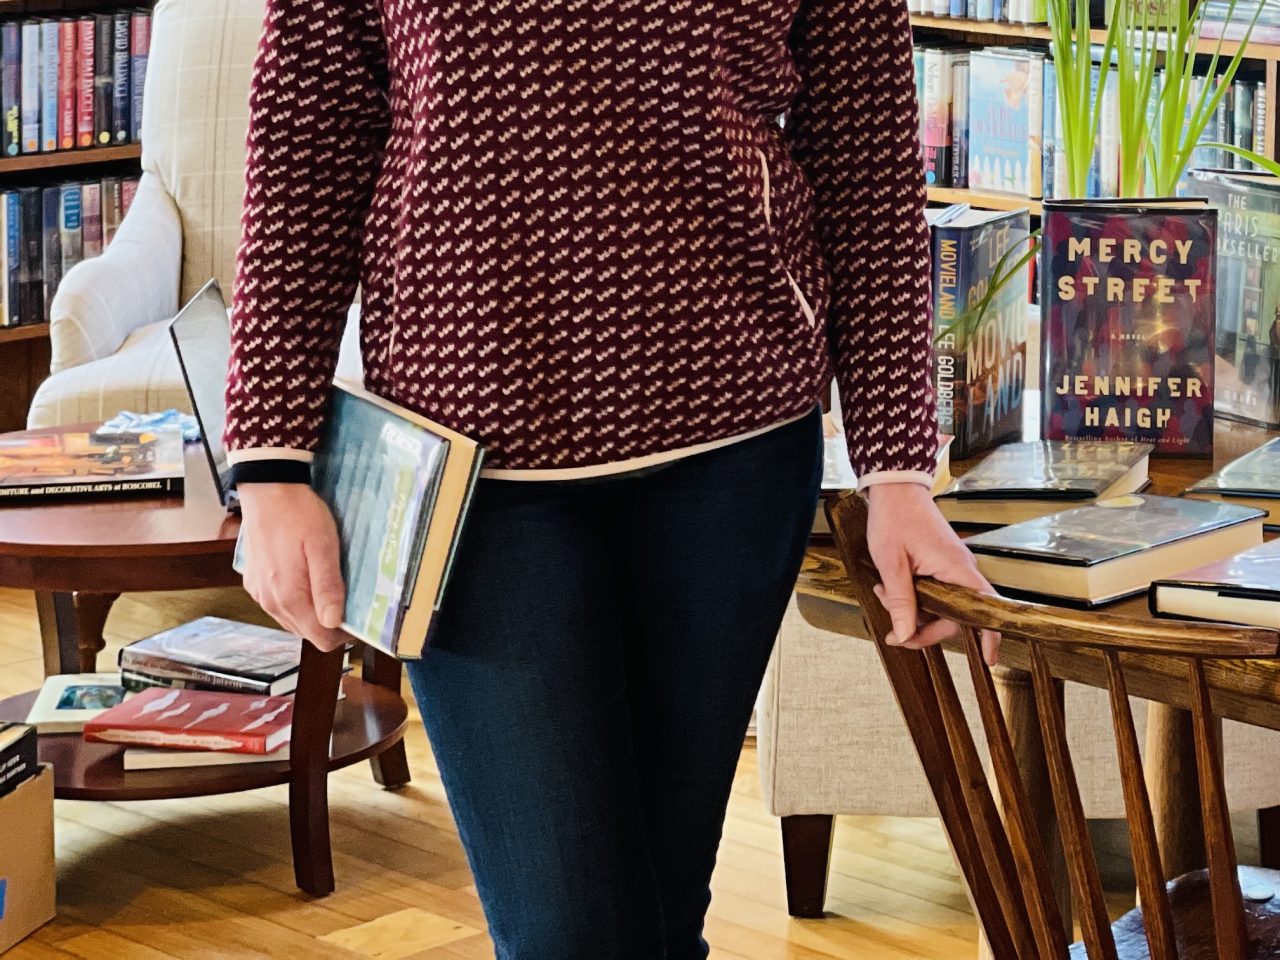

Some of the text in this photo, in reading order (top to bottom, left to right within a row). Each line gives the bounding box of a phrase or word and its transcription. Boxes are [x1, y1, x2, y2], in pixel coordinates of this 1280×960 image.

[81, 20, 95, 113] DAVID BALDACCI
[114, 20, 128, 97] DAVID BALDACCI
[1256, 86, 1266, 132] WEDDING
[1228, 194, 1247, 210] THE
[989, 224, 1010, 269] LEE
[1068, 237, 1193, 264] MERCY
[1217, 238, 1278, 264] OKSELLER
[1058, 275, 1202, 303] STREET
[937, 240, 958, 427] MOVIELAND LEE GOLDBERG
[966, 294, 1028, 385] MOVIE
[1056, 375, 1202, 398] JENNIFER
[1085, 407, 1171, 429] HAIGH
[29, 486, 44, 495] and
[45, 484, 91, 495] DECORATIVE
[93, 483, 112, 491] ARTS
[122, 481, 162, 491] BOSCOBEL
